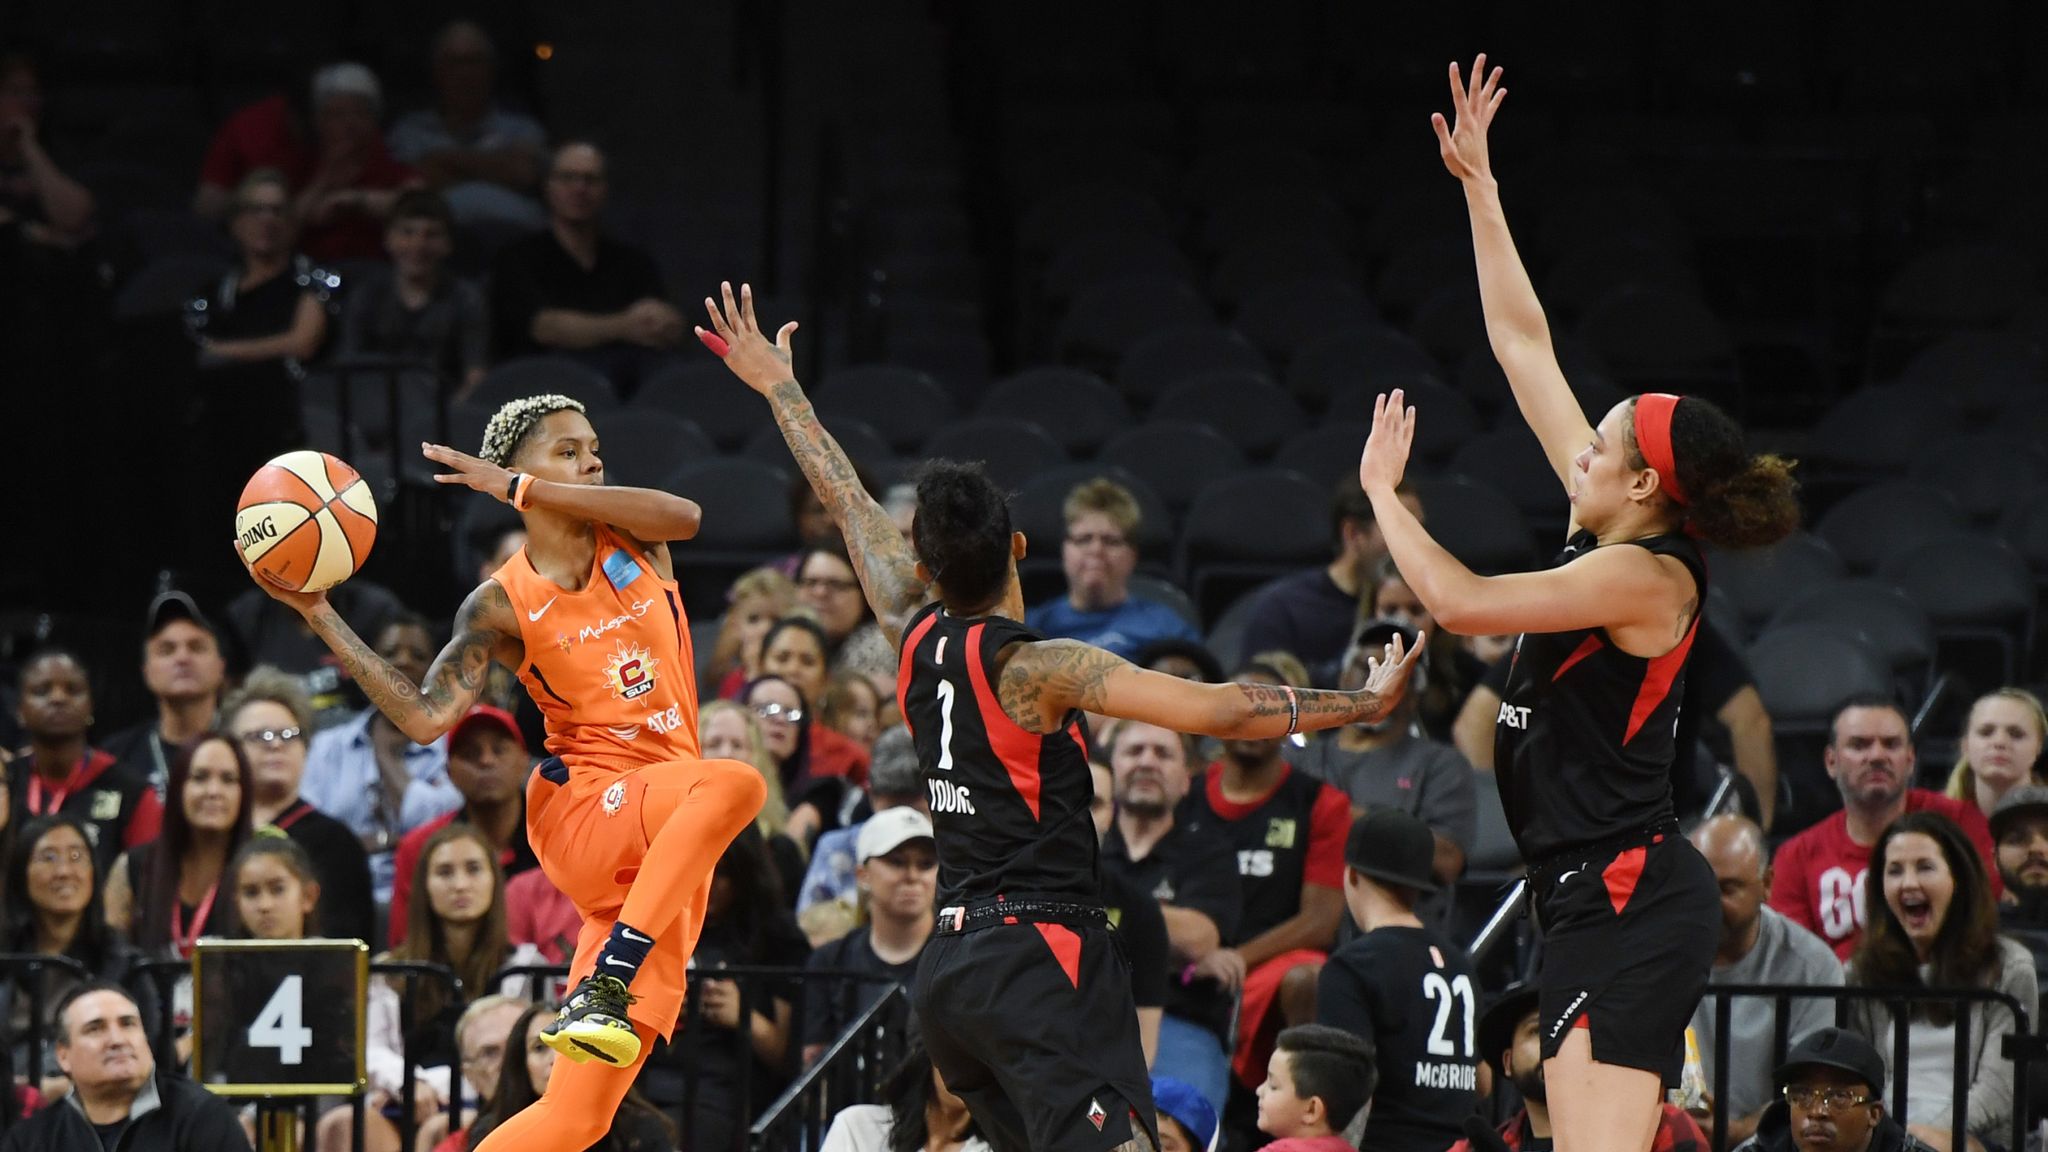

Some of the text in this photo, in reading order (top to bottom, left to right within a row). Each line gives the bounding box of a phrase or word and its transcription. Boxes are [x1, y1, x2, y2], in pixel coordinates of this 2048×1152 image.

[579, 598, 655, 646] Mohegan Sun
[625, 682, 652, 699] SUN
[647, 702, 683, 735] AT&
[937, 679, 955, 771] 1
[247, 974, 313, 1065] 4
[1423, 971, 1475, 1058] 21
[1550, 991, 1588, 1038] LAS VEGAS
